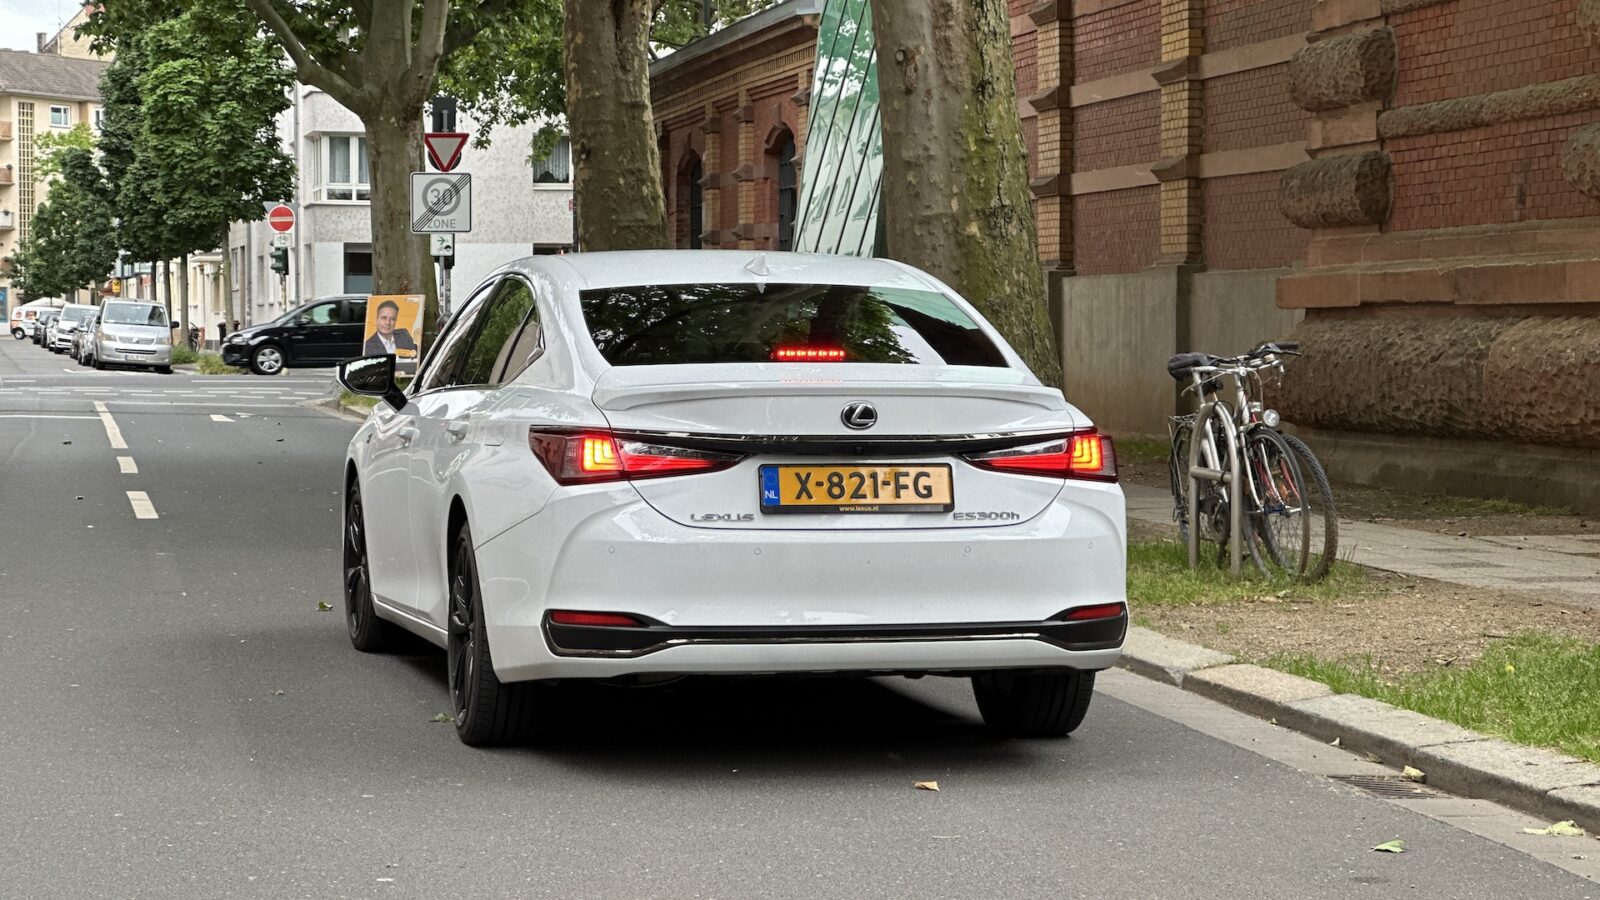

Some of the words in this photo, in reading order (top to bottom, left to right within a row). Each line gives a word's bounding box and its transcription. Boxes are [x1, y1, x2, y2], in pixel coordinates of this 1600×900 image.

[430, 188, 453, 206] 30
[427, 219, 456, 228] ZONE
[794, 471, 933, 500] X-821-FG
[764, 490, 778, 499] NL
[690, 513, 755, 522] LEXUS
[953, 511, 1021, 521] ES300h
